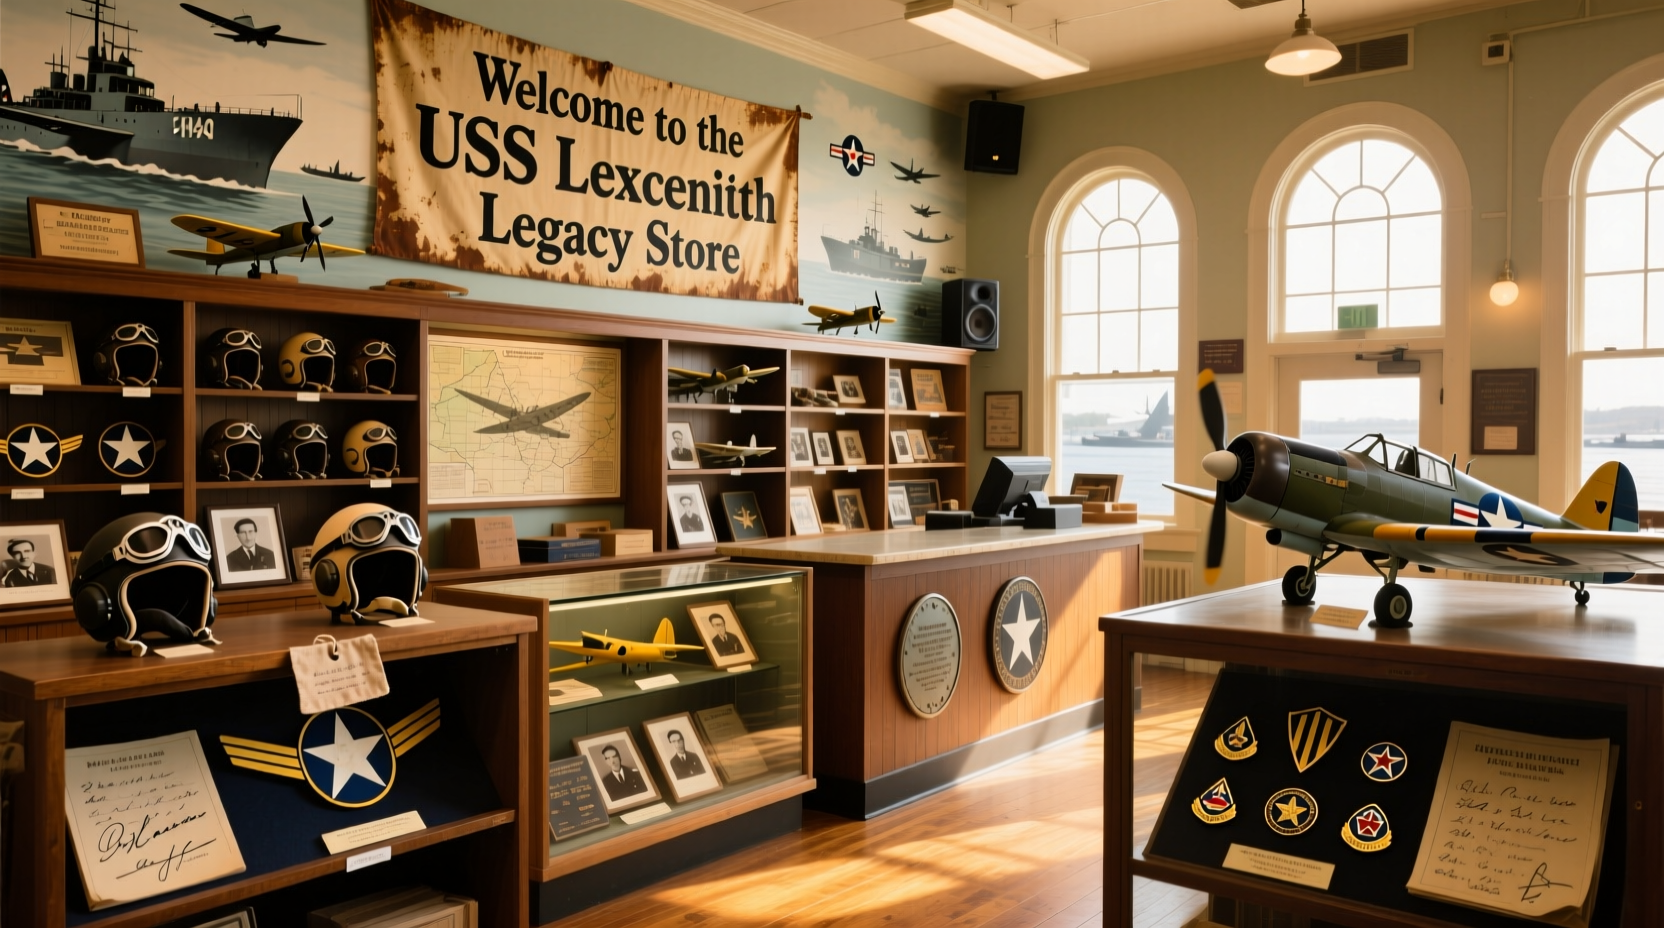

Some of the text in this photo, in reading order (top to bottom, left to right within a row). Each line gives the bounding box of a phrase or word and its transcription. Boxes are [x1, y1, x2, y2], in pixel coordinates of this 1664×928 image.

[416, 104, 538, 185] USS
[473, 51, 744, 158] Welcome to the
[478, 192, 740, 274] Legacy Store
